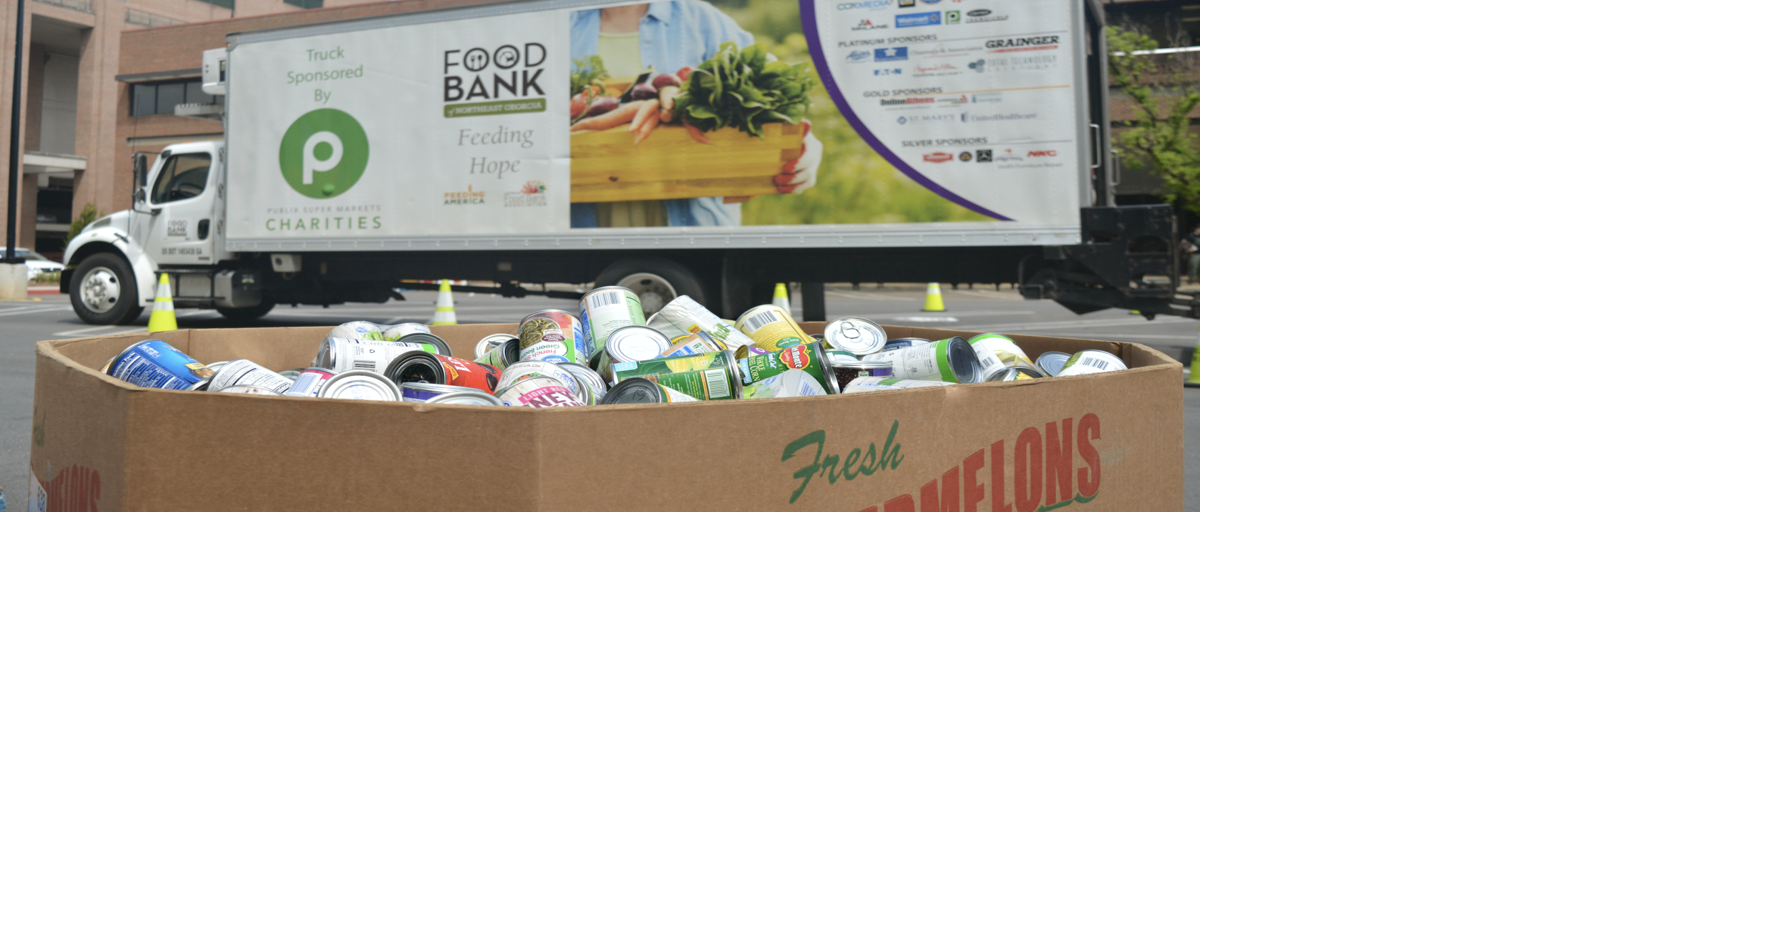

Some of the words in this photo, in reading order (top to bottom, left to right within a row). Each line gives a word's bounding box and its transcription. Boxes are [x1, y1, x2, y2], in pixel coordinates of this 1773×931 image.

[838, 36, 885, 48] PLATINUM
[887, 33, 938, 44] SPONSORS
[985, 36, 1060, 49] GRAINGER
[306, 46, 345, 62] Truck
[444, 42, 547, 75] FOOD
[287, 65, 364, 86] Sponsored
[444, 68, 546, 102] BANK
[863, 90, 890, 98] GOLD
[892, 87, 943, 96] SPONSORS
[314, 89, 332, 105] By
[455, 104, 503, 114] NORTHEAST
[504, 102, 542, 111] GEORGIA
[458, 125, 534, 149] Feeding
[901, 139, 933, 148] SILVER
[935, 137, 988, 146] SPONSORS
[470, 156, 521, 179] Hope
[444, 189, 485, 199] FEEDING
[303, 205, 332, 213] SUPER
[336, 203, 382, 212] MARKETS
[265, 215, 382, 231] CHARITIES
[532, 349, 557, 358] French
[750, 365, 760, 382] CORN
[523, 387, 549, 401] LIGHT
[781, 419, 905, 504] Fresh
[858, 413, 1101, 512] MELONS
